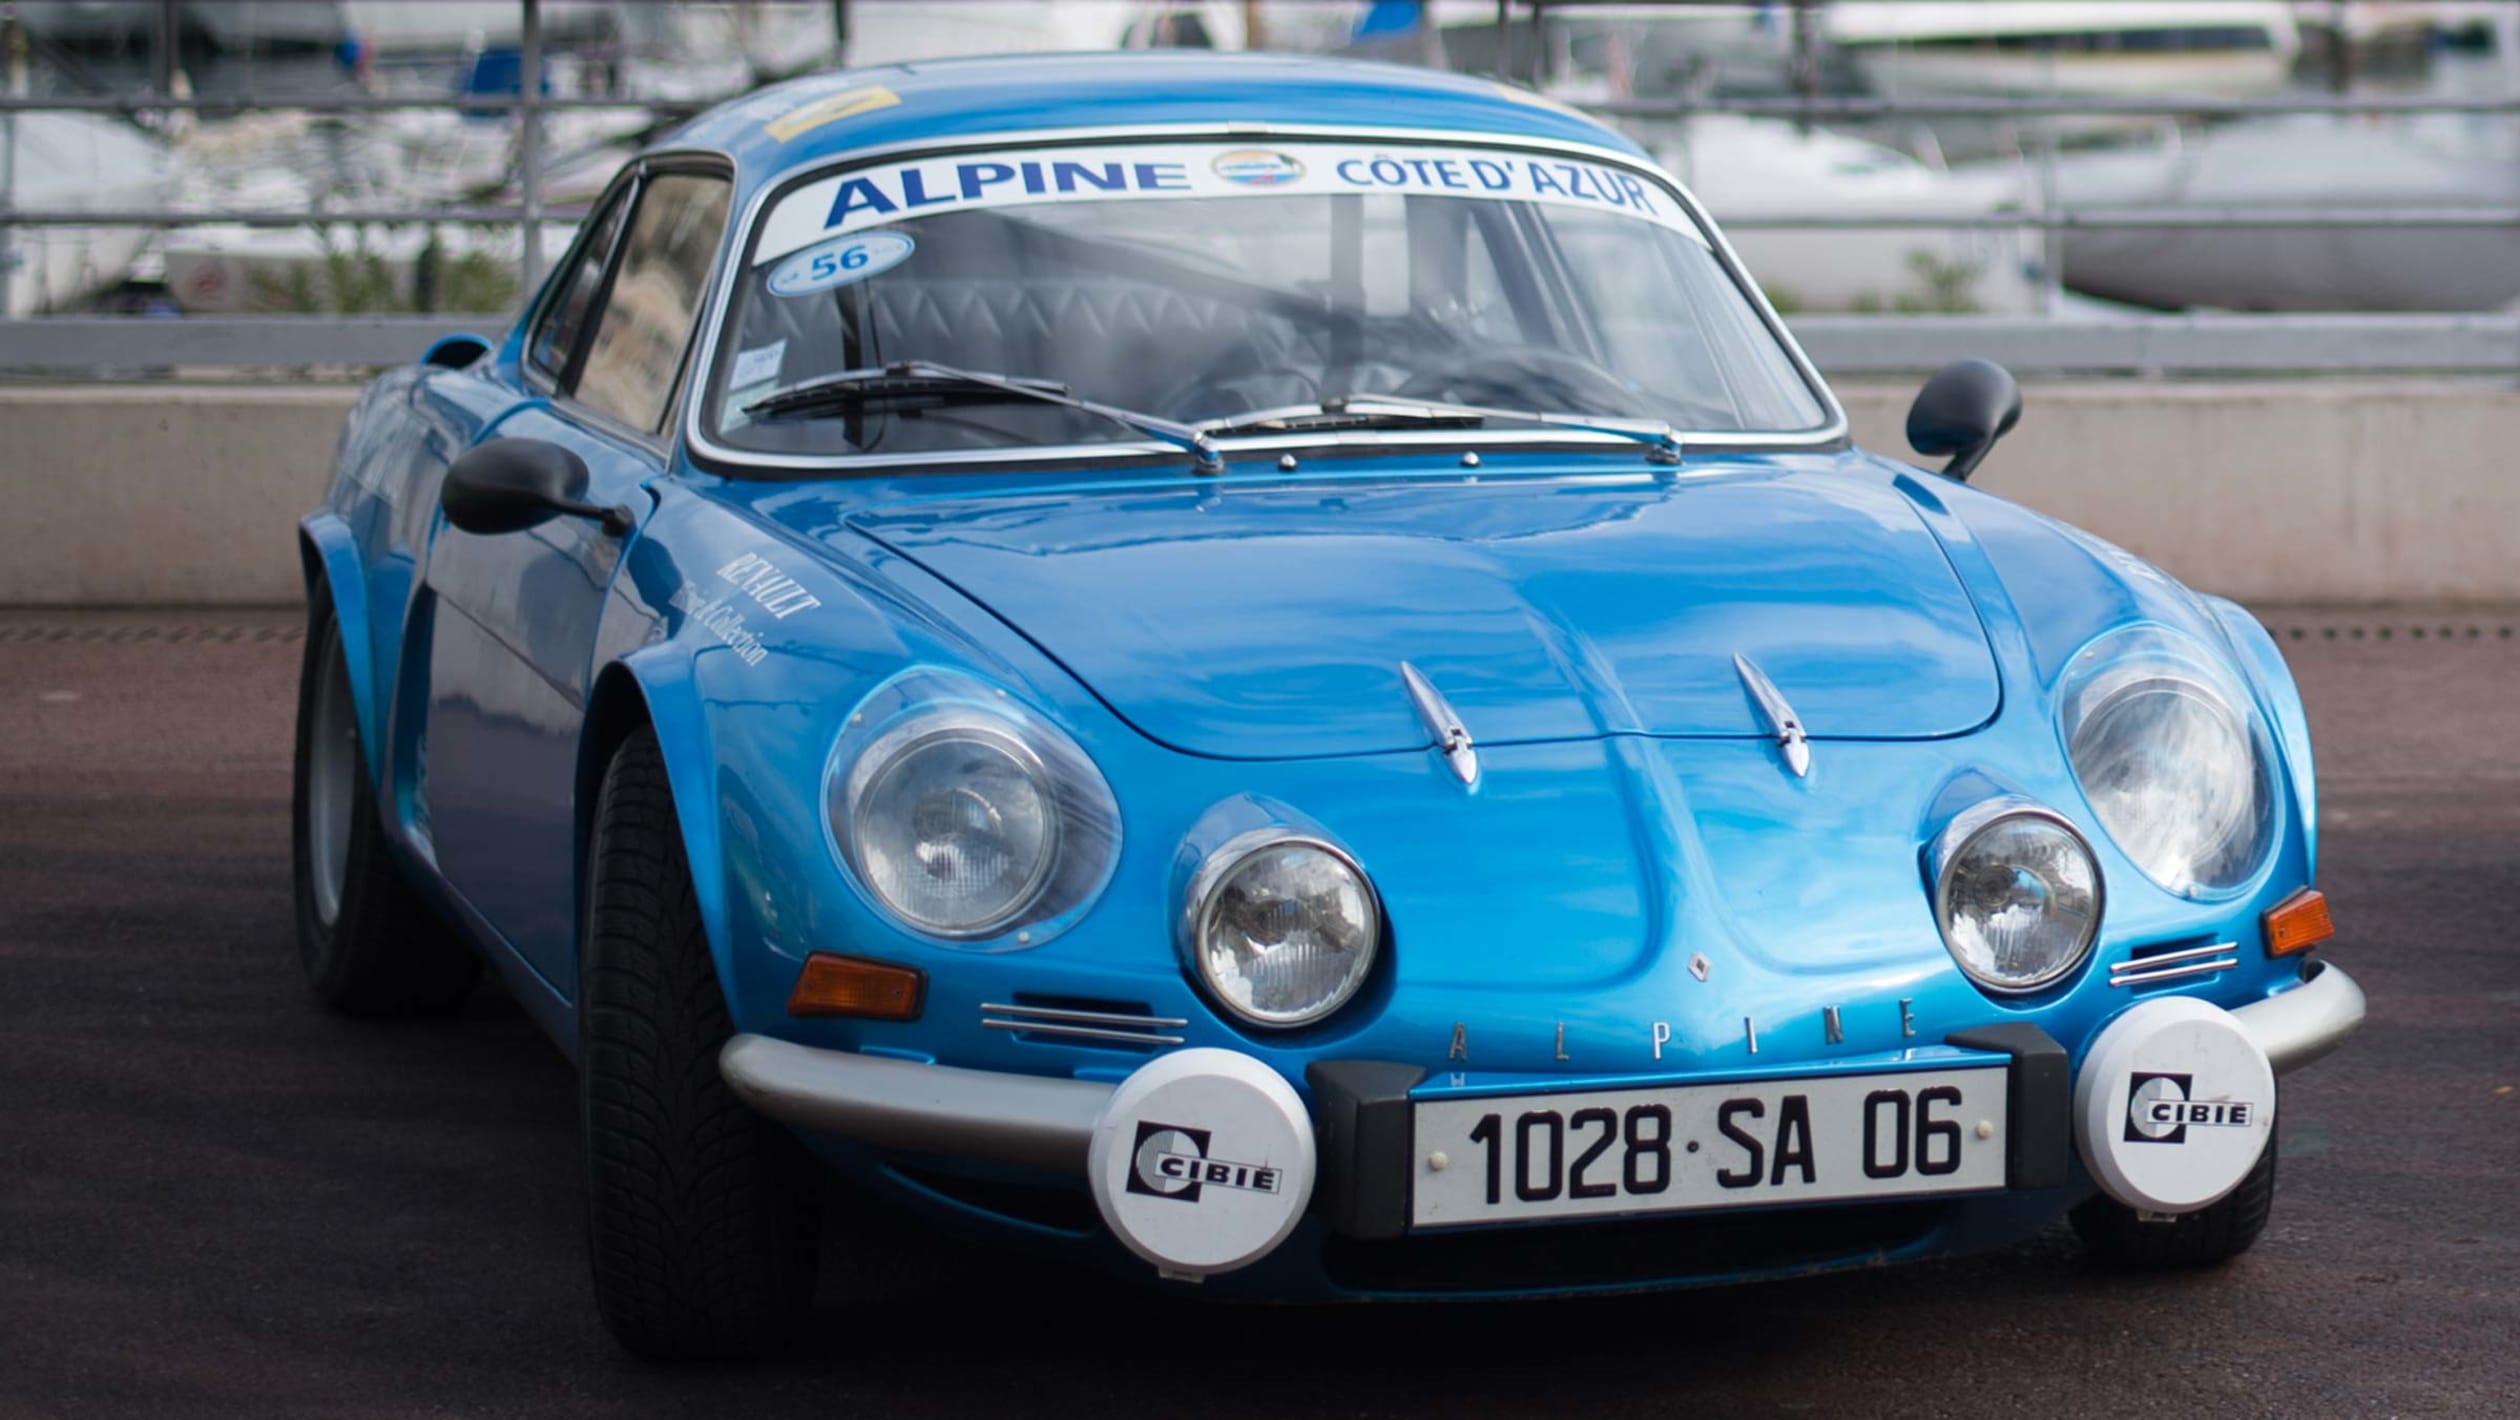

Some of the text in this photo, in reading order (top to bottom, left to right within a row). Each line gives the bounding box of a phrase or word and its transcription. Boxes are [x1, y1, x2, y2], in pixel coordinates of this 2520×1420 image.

[824, 161, 1191, 230] ALPINE
[1336, 154, 1468, 189] CÔTE
[810, 244, 870, 281] 56
[1448, 999, 1917, 1062] ALPINE
[1468, 1085, 1964, 1205] 1028 SA 06
